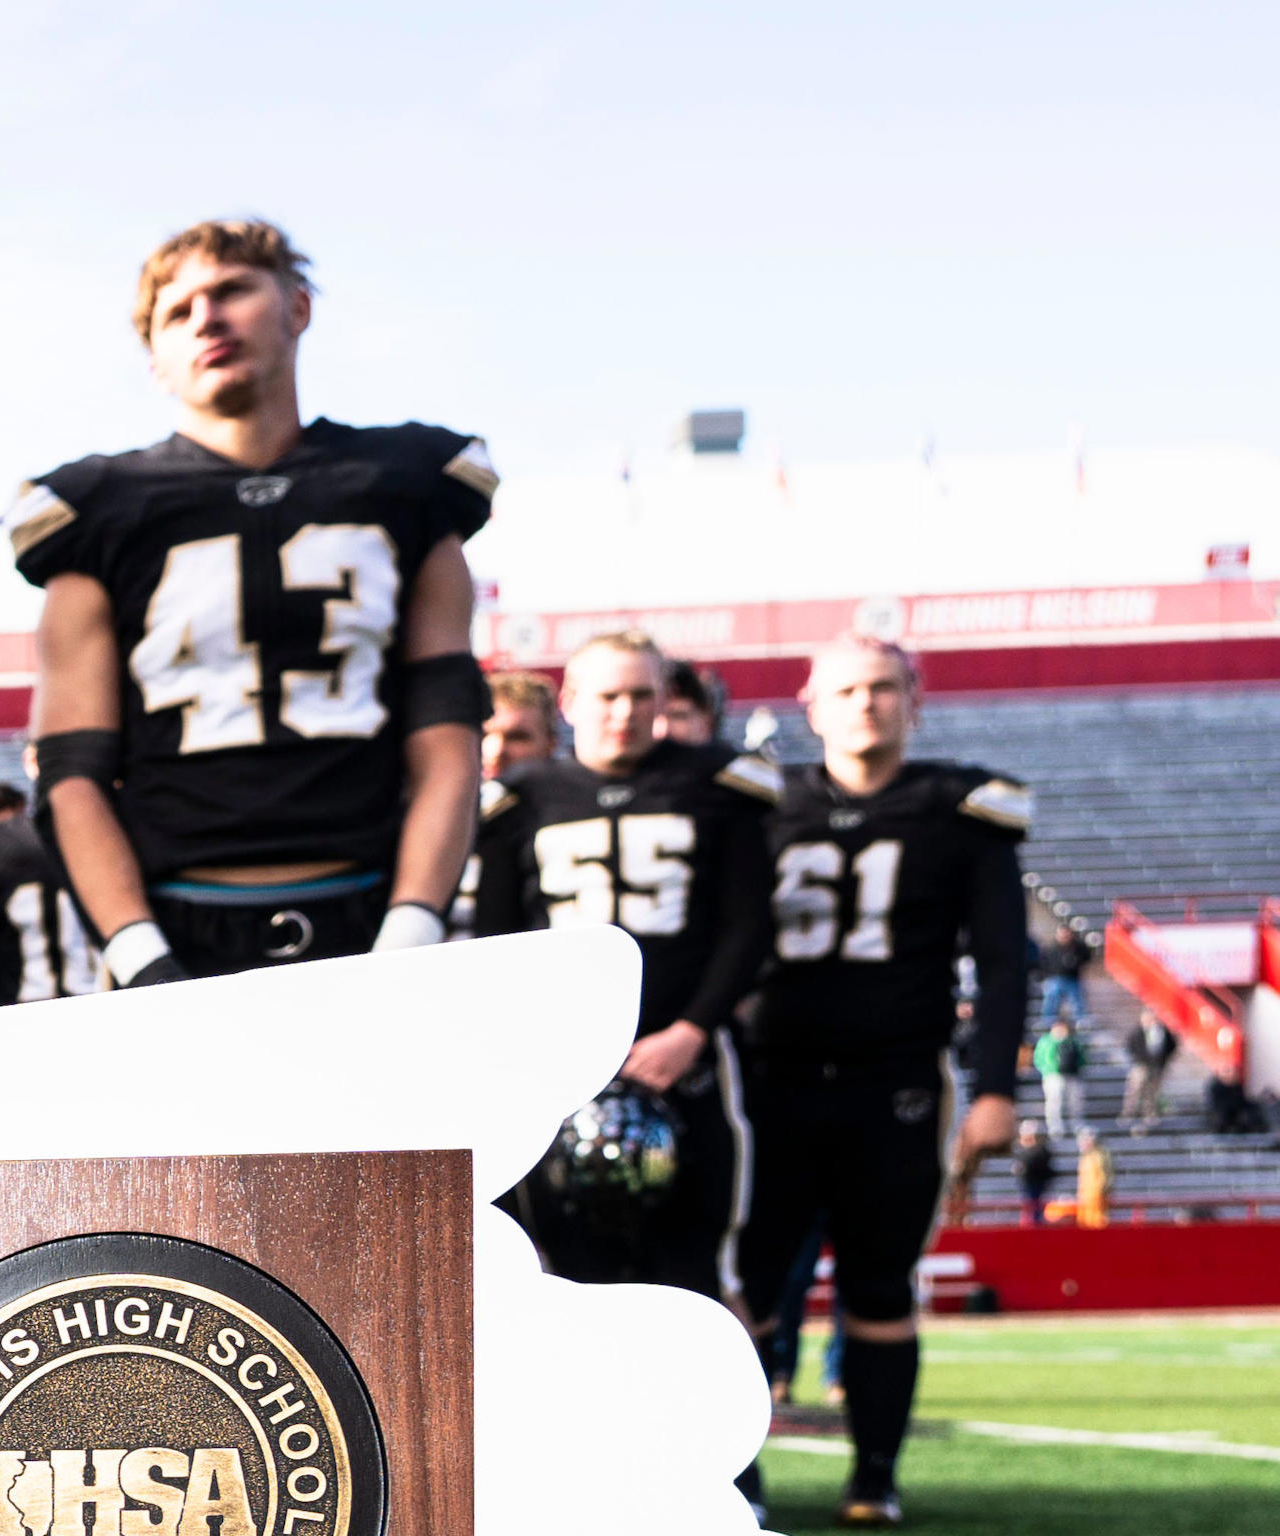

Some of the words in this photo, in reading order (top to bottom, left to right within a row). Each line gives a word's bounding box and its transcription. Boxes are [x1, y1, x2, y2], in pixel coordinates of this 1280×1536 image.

[129, 523, 402, 754] 43
[535, 813, 697, 938] 55
[772, 839, 902, 962] 61
[52, 1297, 194, 1345] HIGH
[207, 1327, 327, 1535] SCHOOL
